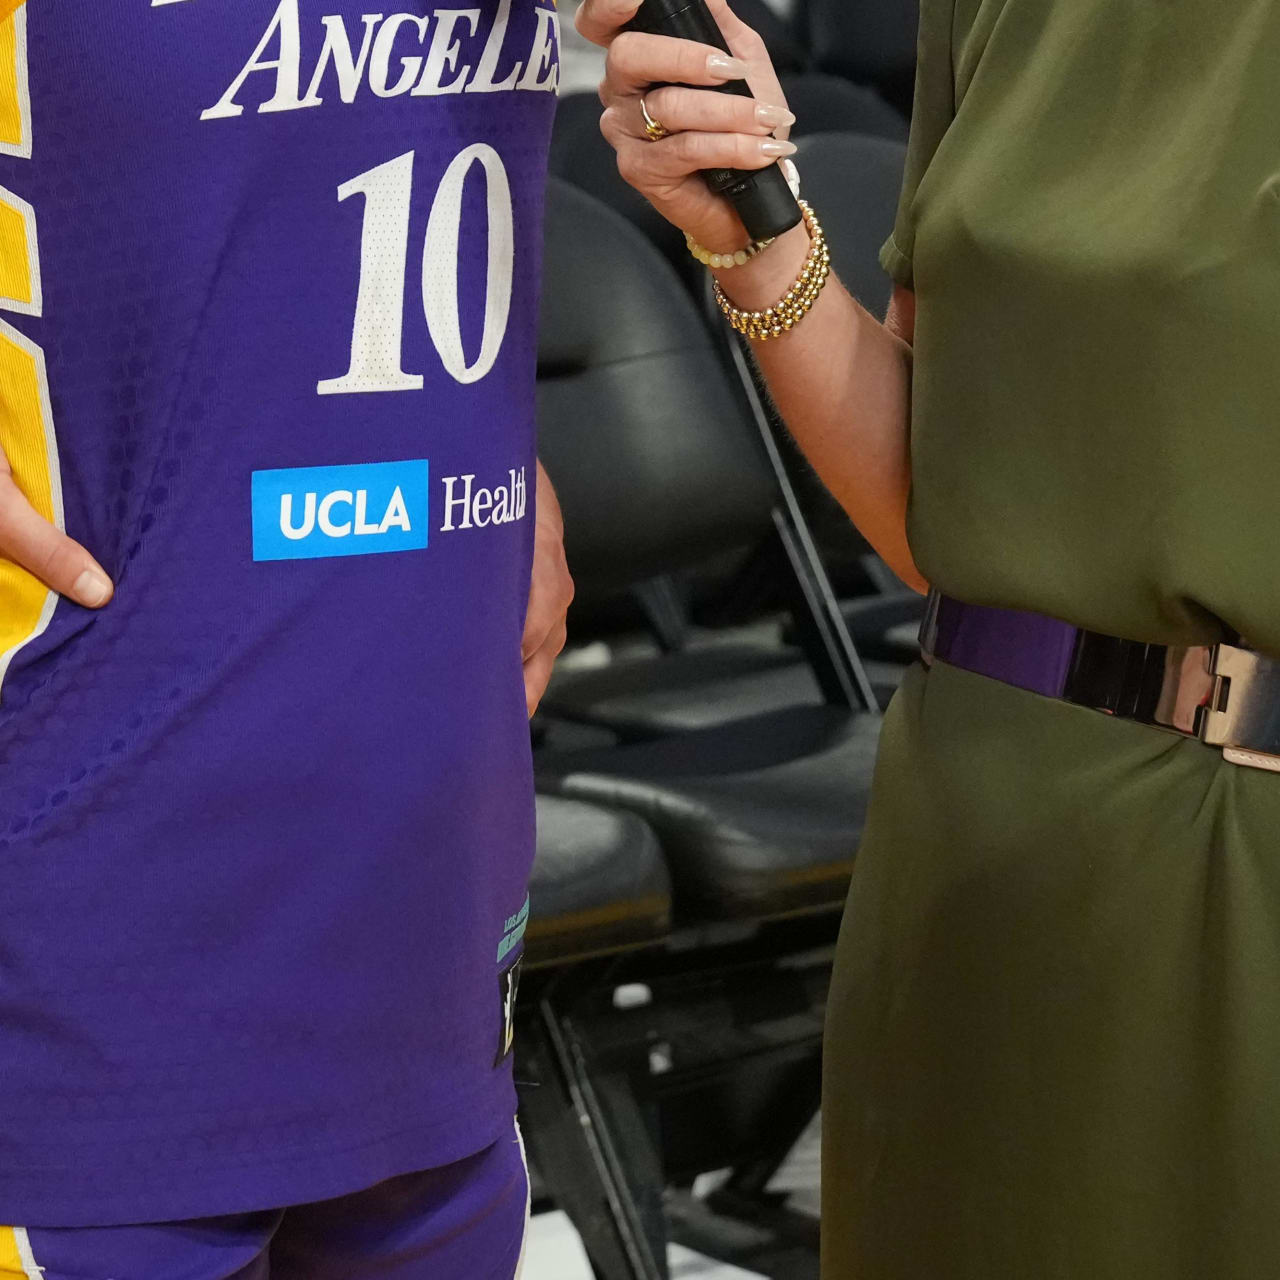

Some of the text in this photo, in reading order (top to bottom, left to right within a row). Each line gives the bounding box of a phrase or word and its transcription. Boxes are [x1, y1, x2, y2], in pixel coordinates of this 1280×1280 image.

[316, 142, 515, 395] 10
[279, 466, 526, 540] UCLA Health
